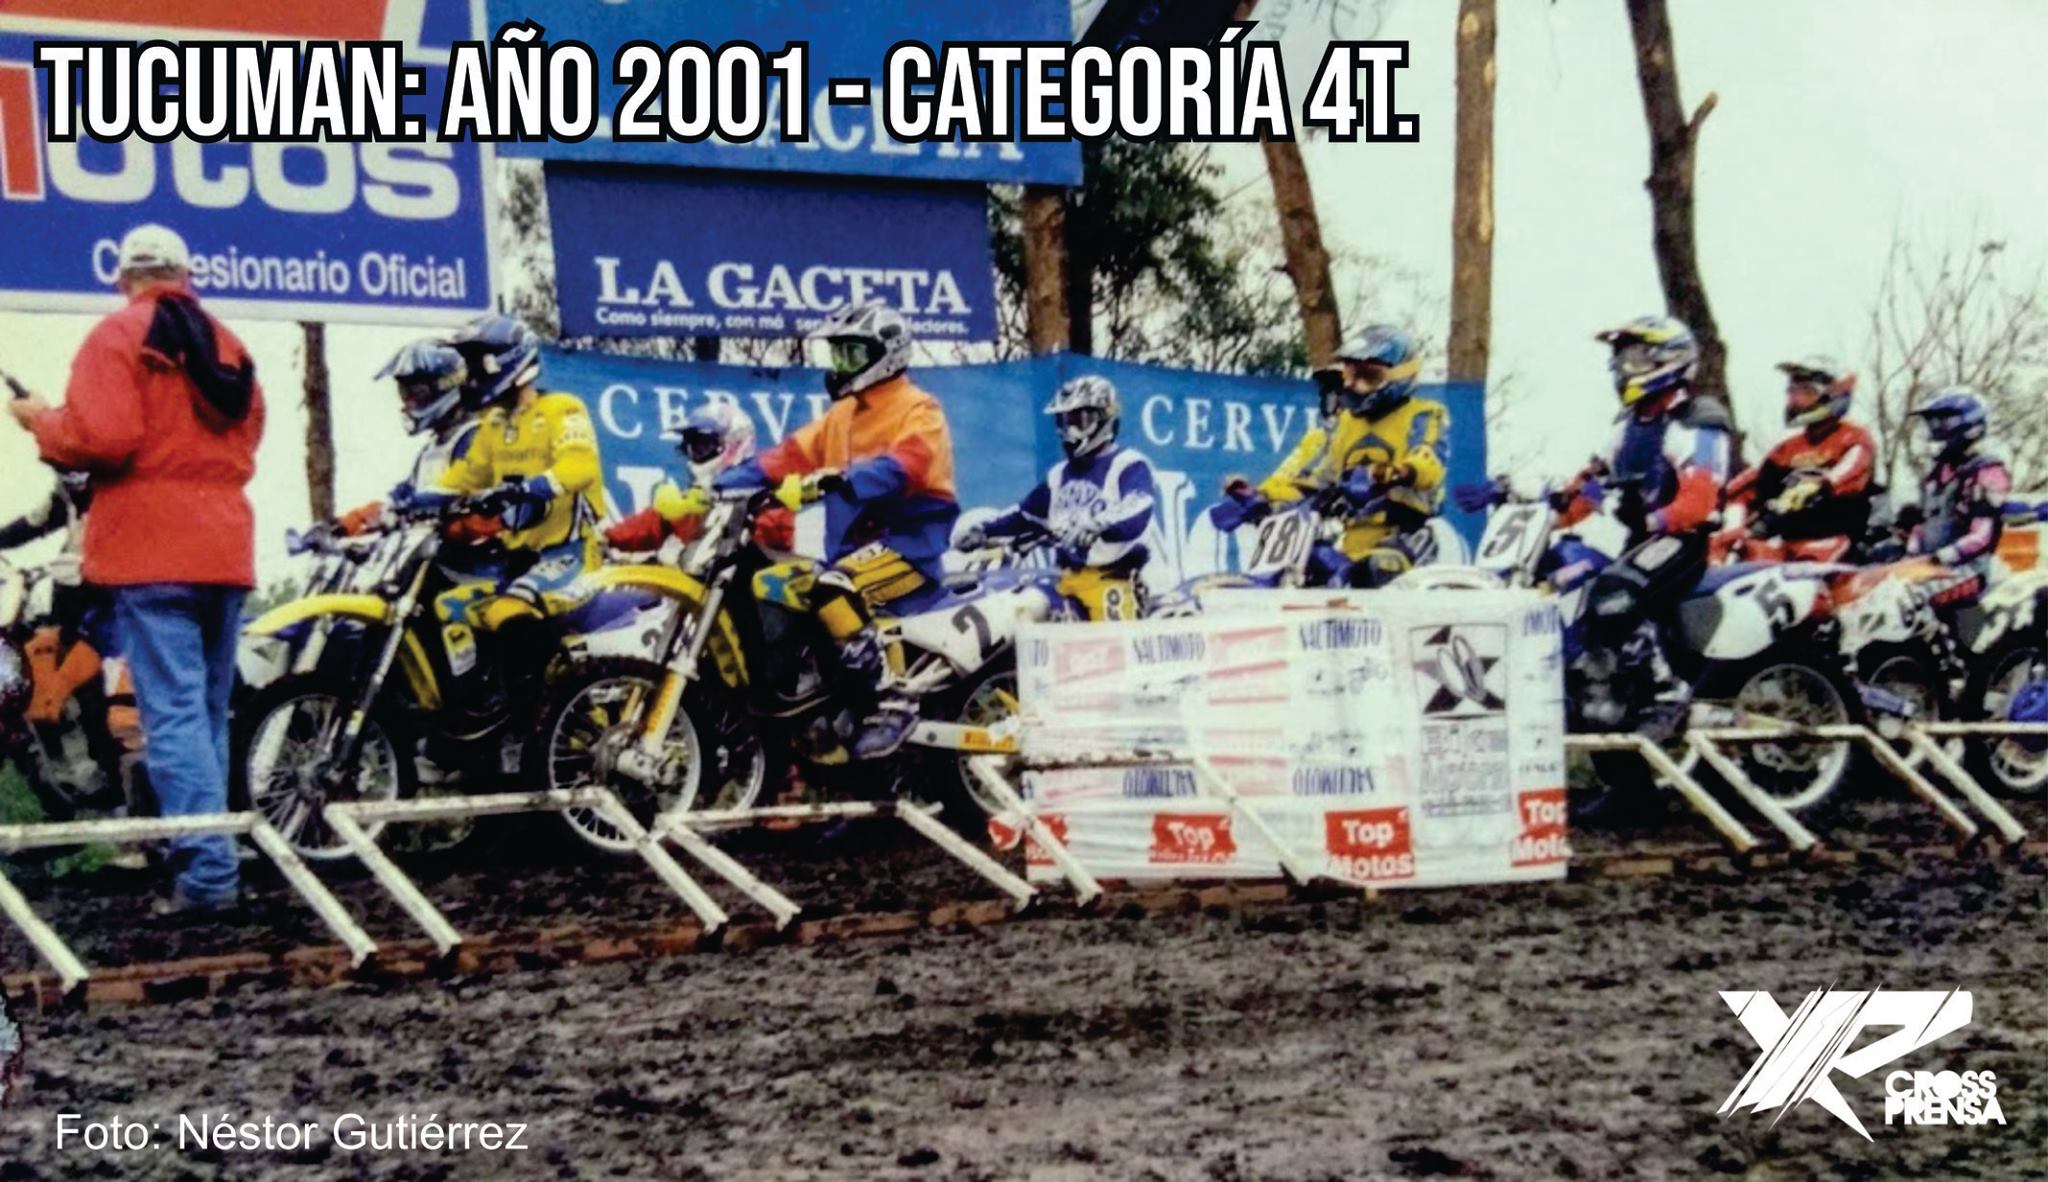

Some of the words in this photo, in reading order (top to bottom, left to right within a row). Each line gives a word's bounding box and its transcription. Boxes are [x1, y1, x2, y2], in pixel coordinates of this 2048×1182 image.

[92, 238, 350, 294] Cesionario
[359, 251, 466, 299] Oficial
[594, 256, 694, 308] LA
[706, 261, 972, 315] GACETA
[595, 307, 646, 326] Como
[650, 308, 720, 331] siempre,
[725, 315, 755, 328] con
[1167, 821, 1216, 852] Top
[1341, 819, 1394, 848] Top
